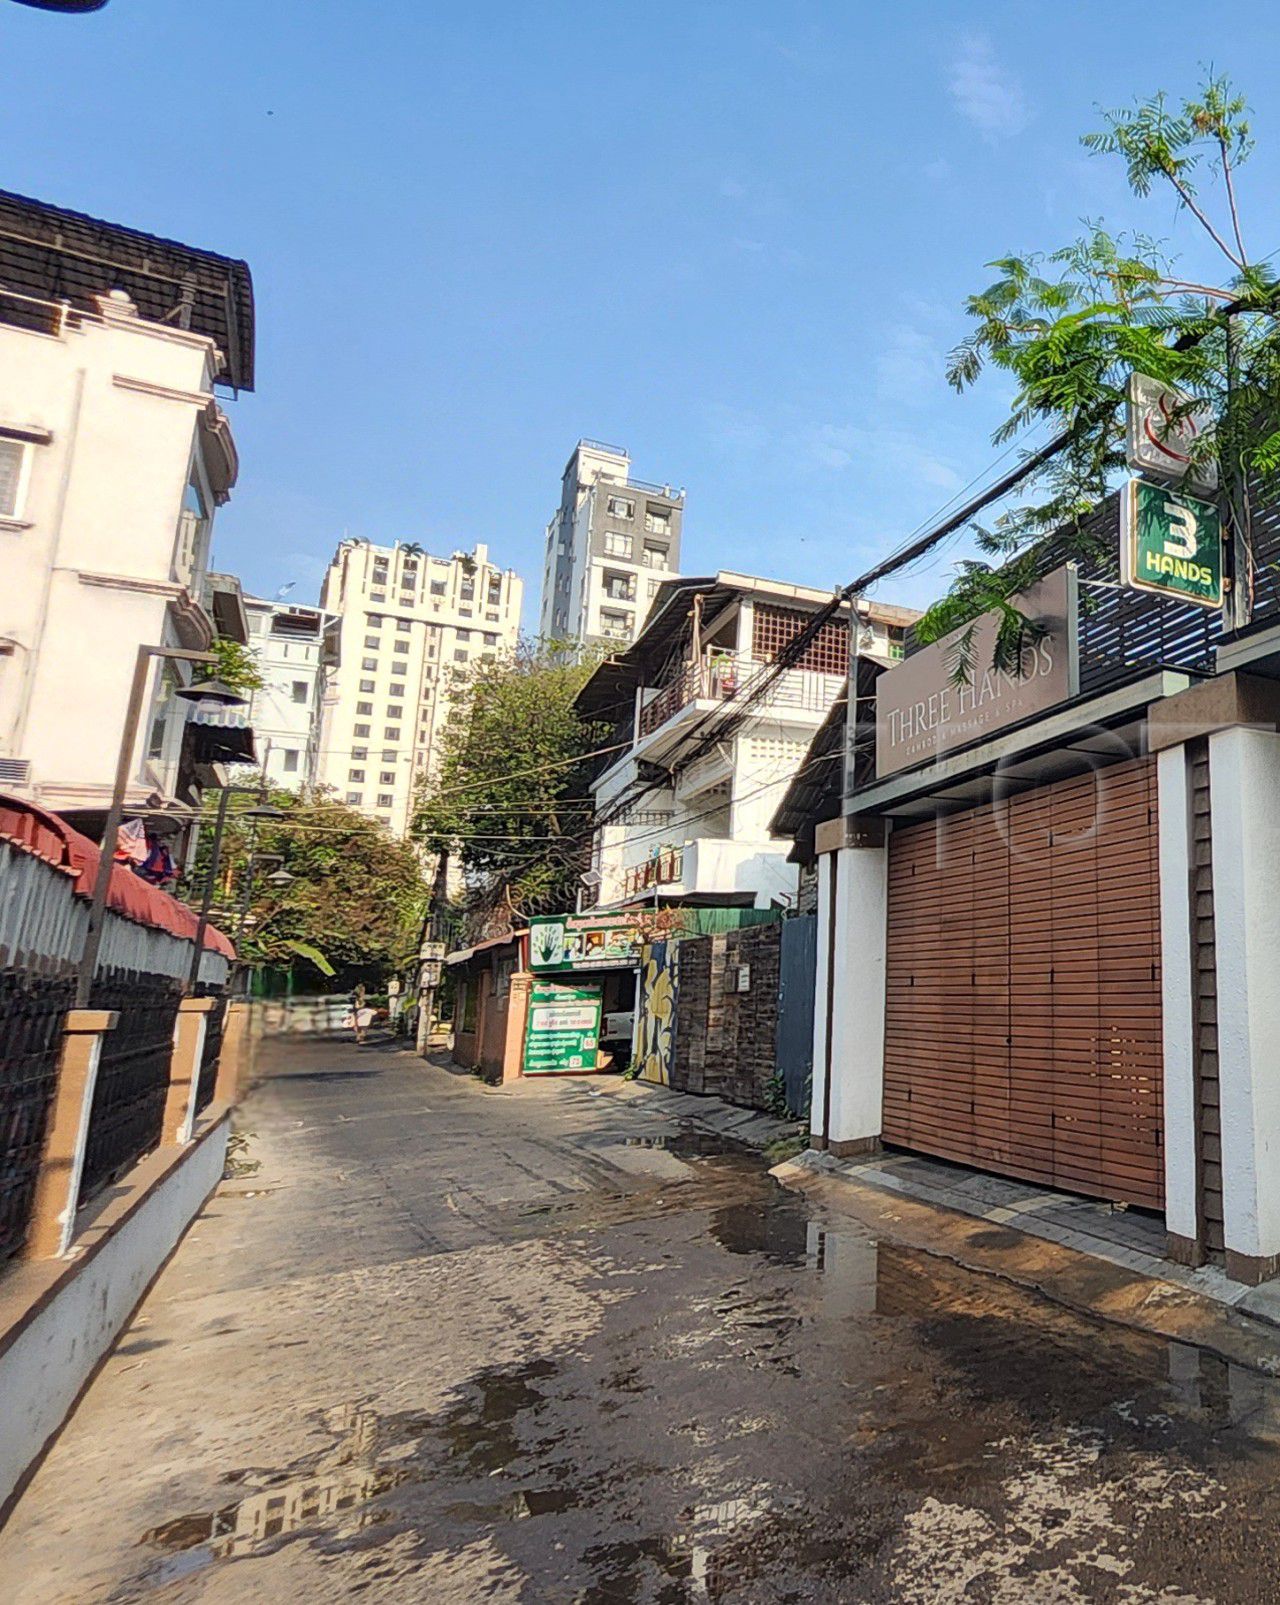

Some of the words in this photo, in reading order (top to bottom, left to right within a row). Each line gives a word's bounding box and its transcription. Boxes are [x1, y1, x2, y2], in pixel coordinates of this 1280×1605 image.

[1163, 501, 1197, 559] 3
[1146, 550, 1213, 586] HANDS
[887, 688, 951, 747] THREE
[959, 635, 1053, 714] HANDS
[951, 711, 991, 735] MASSAGE
